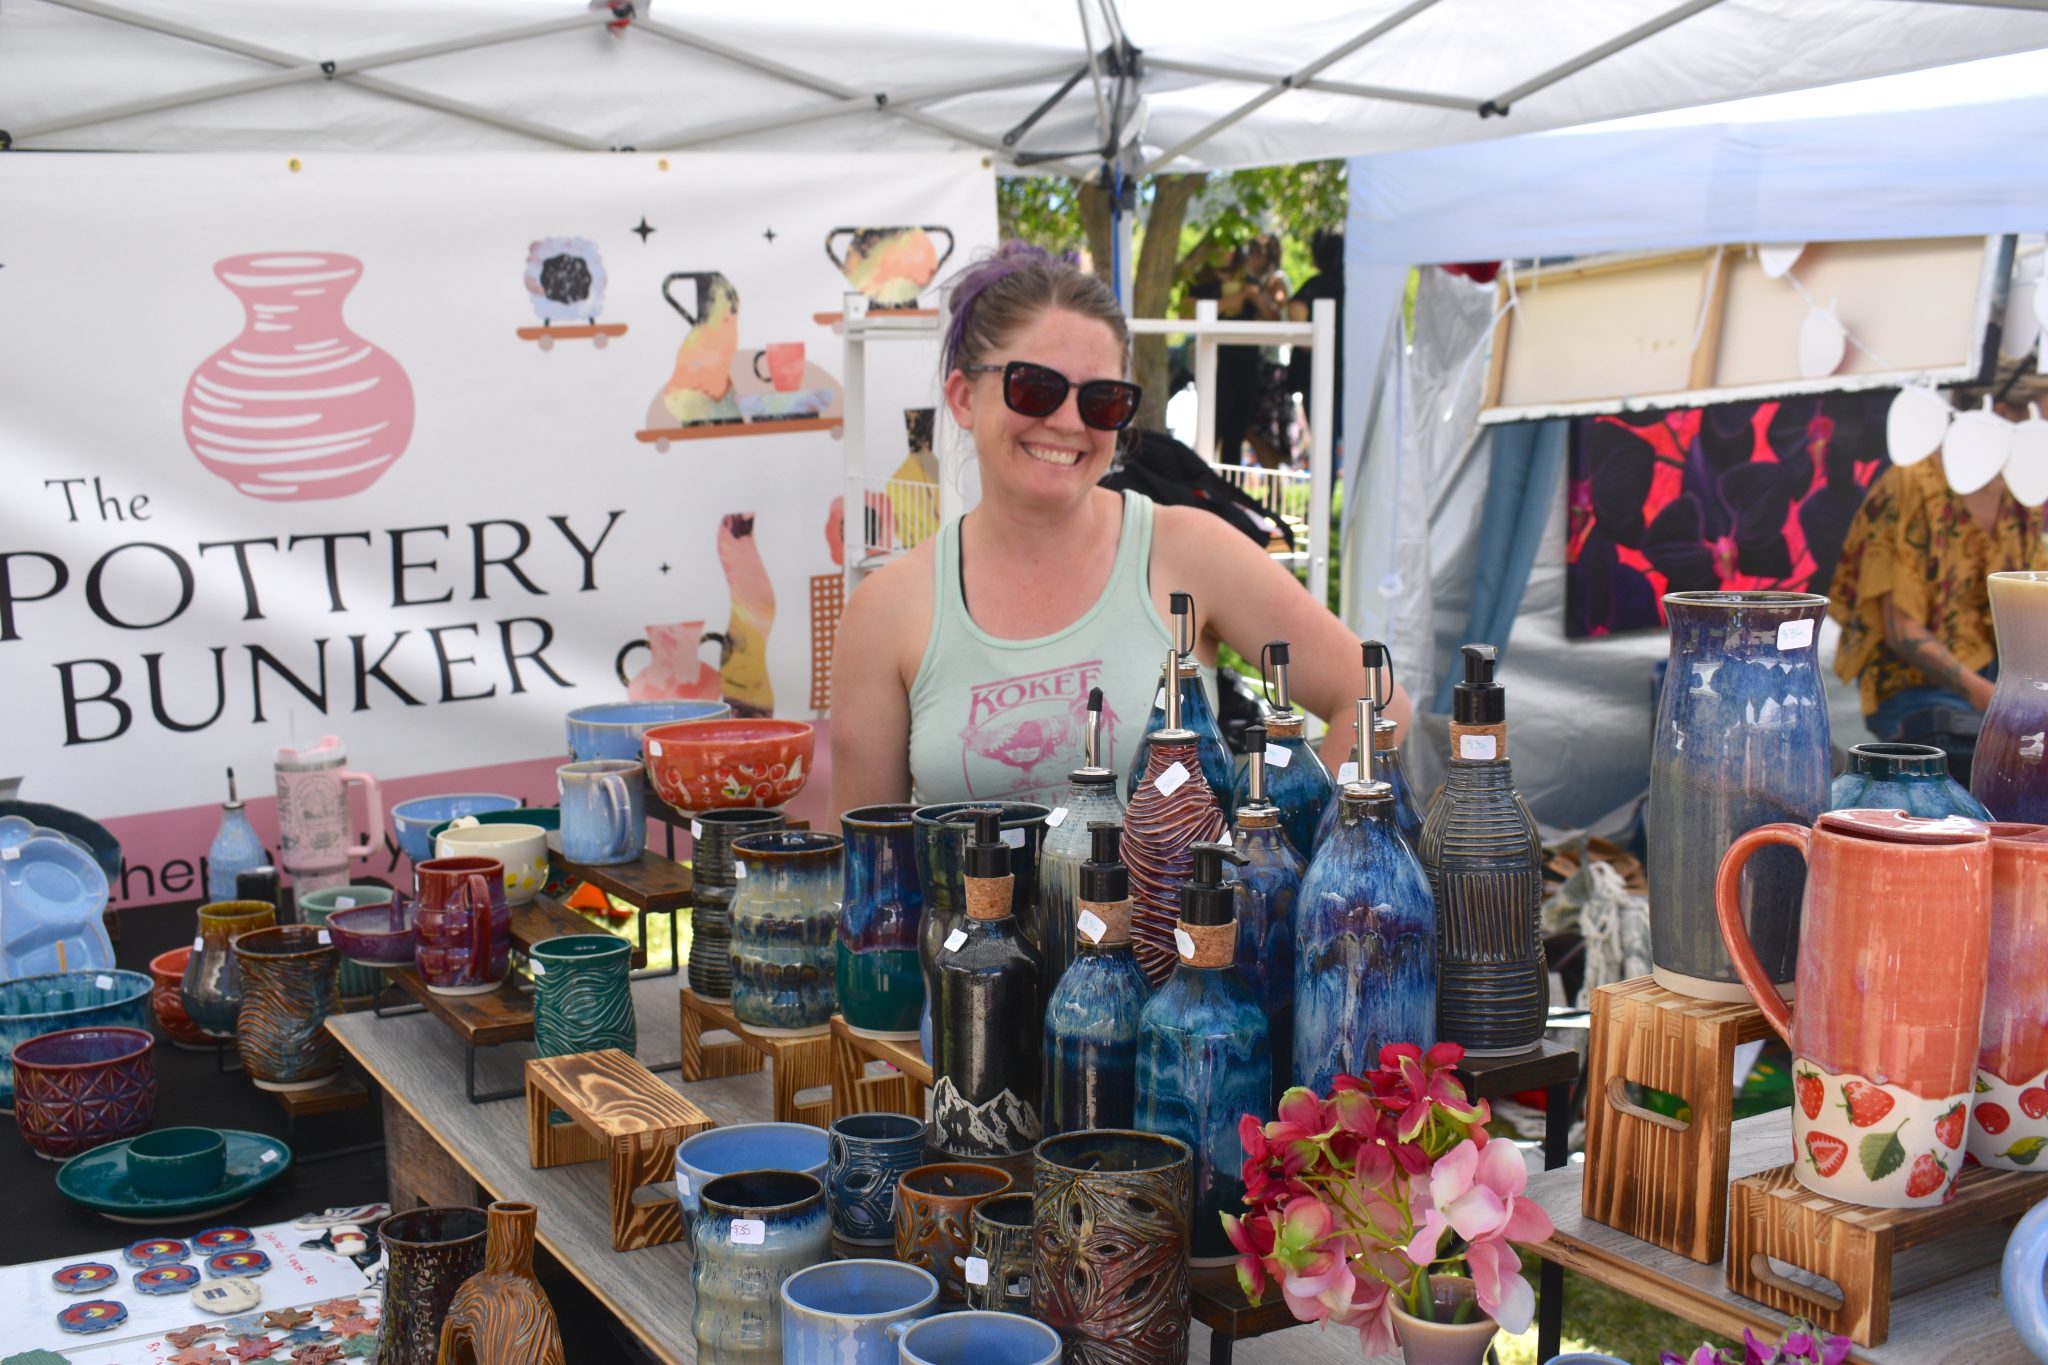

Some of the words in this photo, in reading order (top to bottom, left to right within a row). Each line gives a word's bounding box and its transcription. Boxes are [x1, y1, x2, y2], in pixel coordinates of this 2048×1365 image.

[45, 476, 153, 522] The
[0, 509, 627, 642] POTTERY
[53, 615, 577, 748] BUNKER
[730, 1223, 751, 1238] $35
